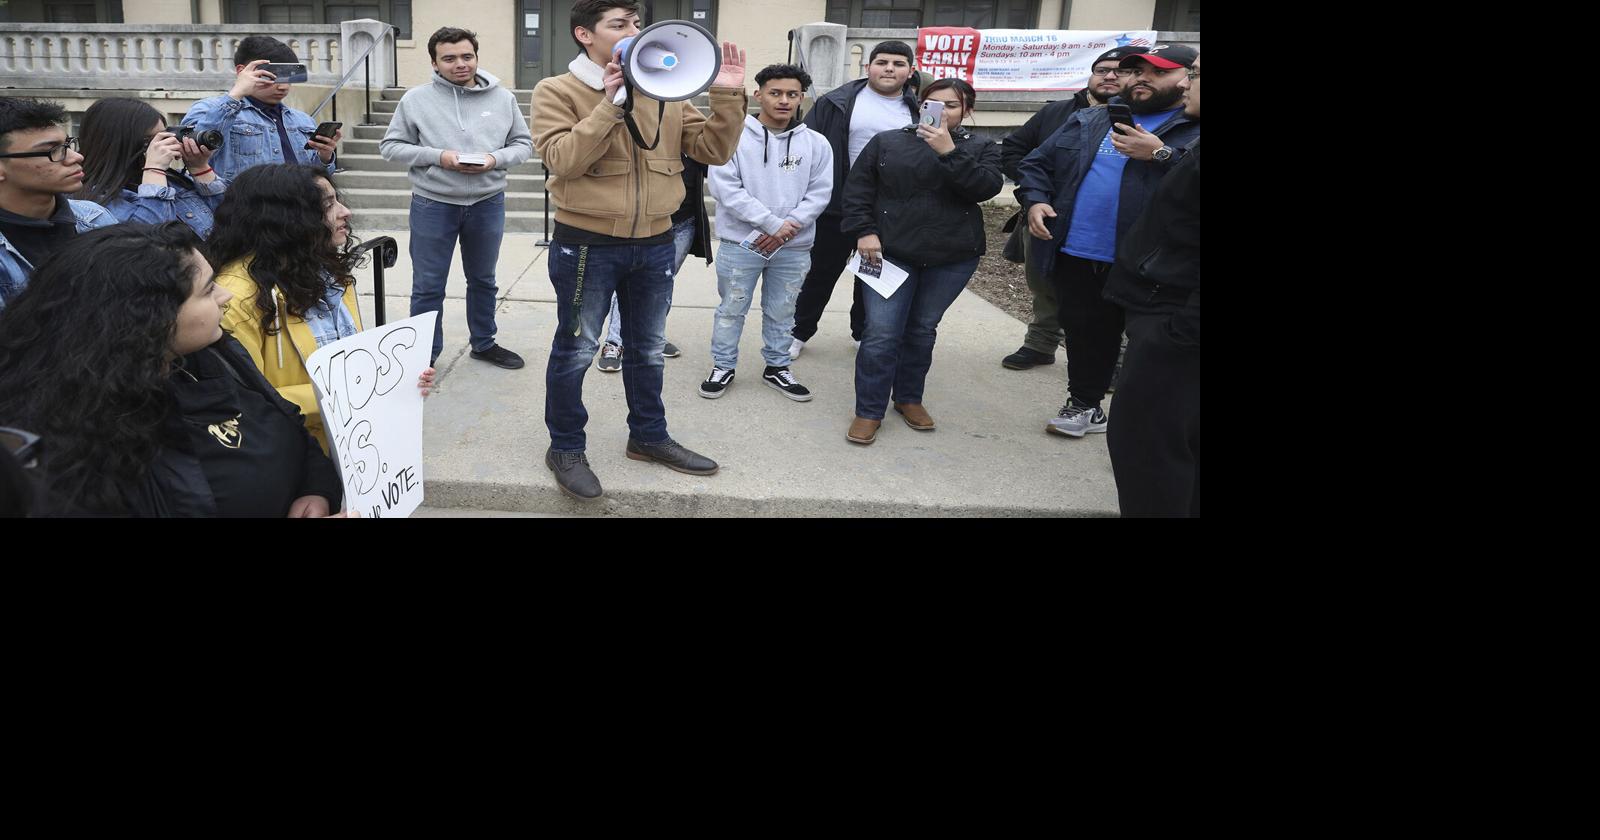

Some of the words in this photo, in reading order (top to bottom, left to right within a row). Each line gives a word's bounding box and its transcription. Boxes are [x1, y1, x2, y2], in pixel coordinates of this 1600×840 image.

[925, 34, 974, 51] VOTE
[1046, 34, 1058, 42] 16
[1022, 43, 1060, 51] Saturday:
[1093, 42, 1106, 50] pm
[921, 51, 971, 65] EARLY
[980, 51, 1016, 59] Sundays:
[382, 465, 419, 510] VOTE.
